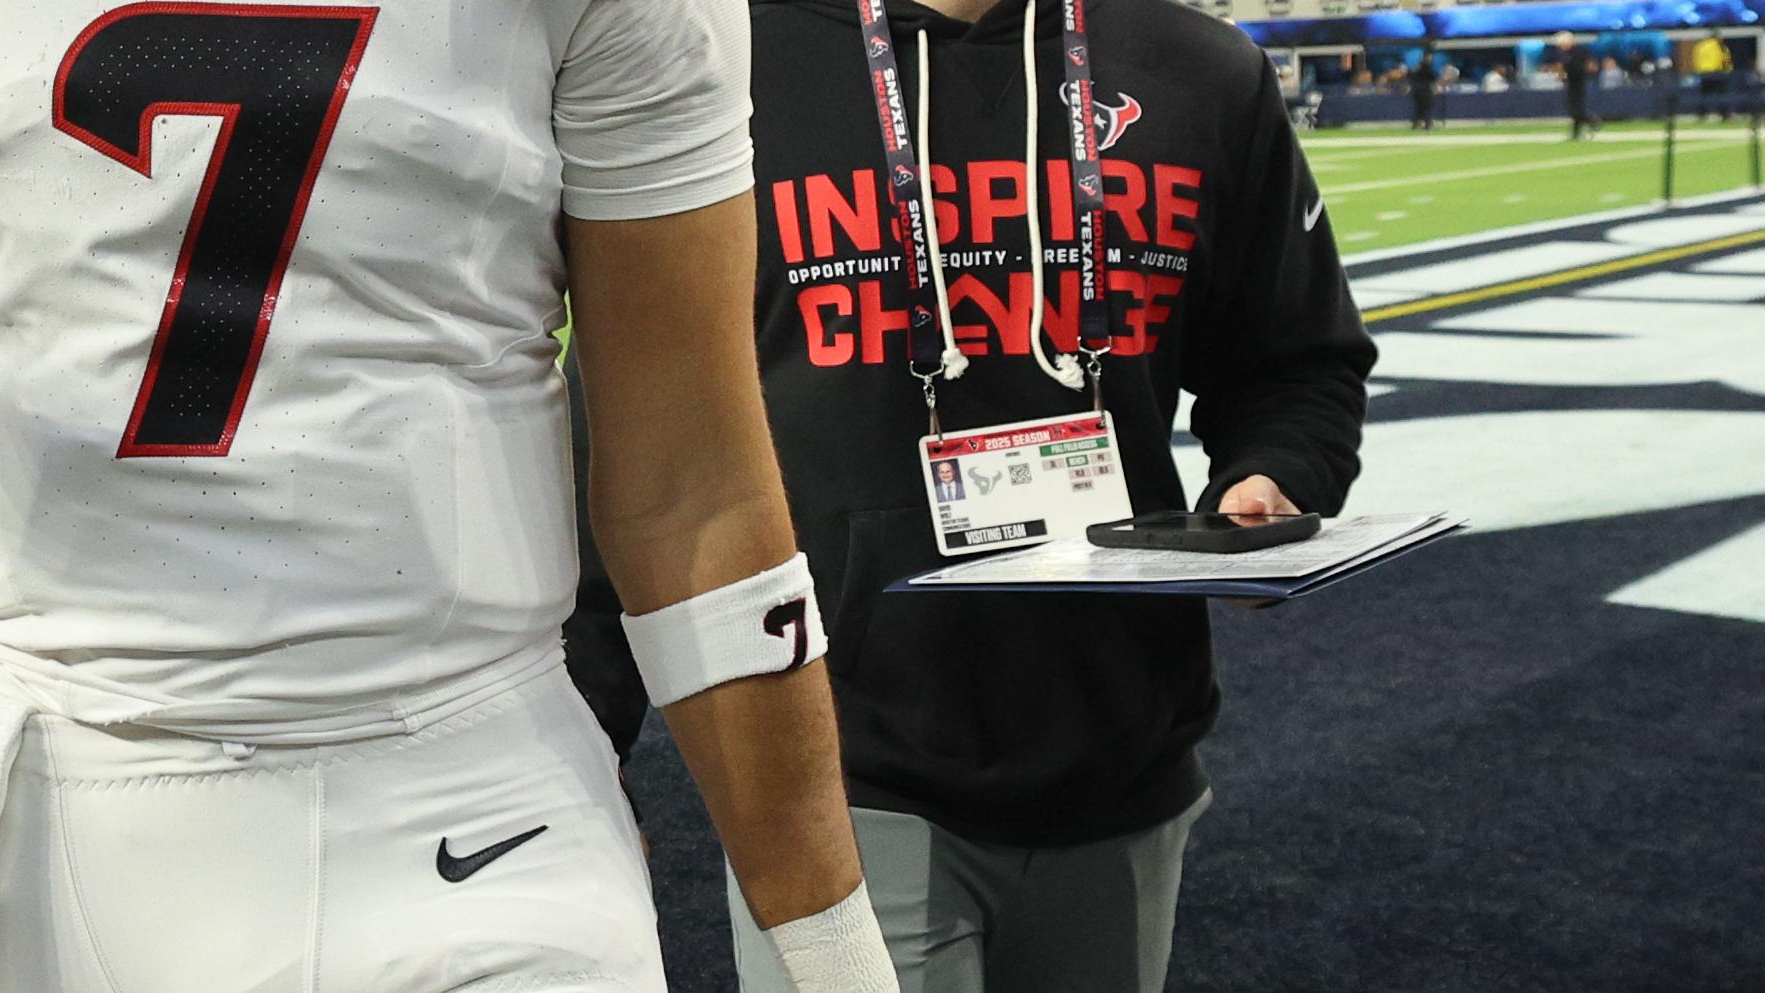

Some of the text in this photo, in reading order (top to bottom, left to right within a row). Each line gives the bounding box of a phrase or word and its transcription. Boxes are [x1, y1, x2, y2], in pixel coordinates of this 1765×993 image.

[874, 69, 898, 153] HOUSTON
[884, 66, 909, 151] TEXANS
[1070, 79, 1086, 162] TEXANS
[1079, 79, 1099, 161] HOUSTON
[52, 0, 381, 459] 7
[788, 256, 902, 284] OPPORTUNIT
[908, 198, 929, 289] TEXANS
[1080, 210, 1094, 302] TEXANS
[984, 430, 1051, 450] 2025 SEASON
[965, 523, 1027, 545] VISITING TEAM
[763, 597, 808, 670] 7
